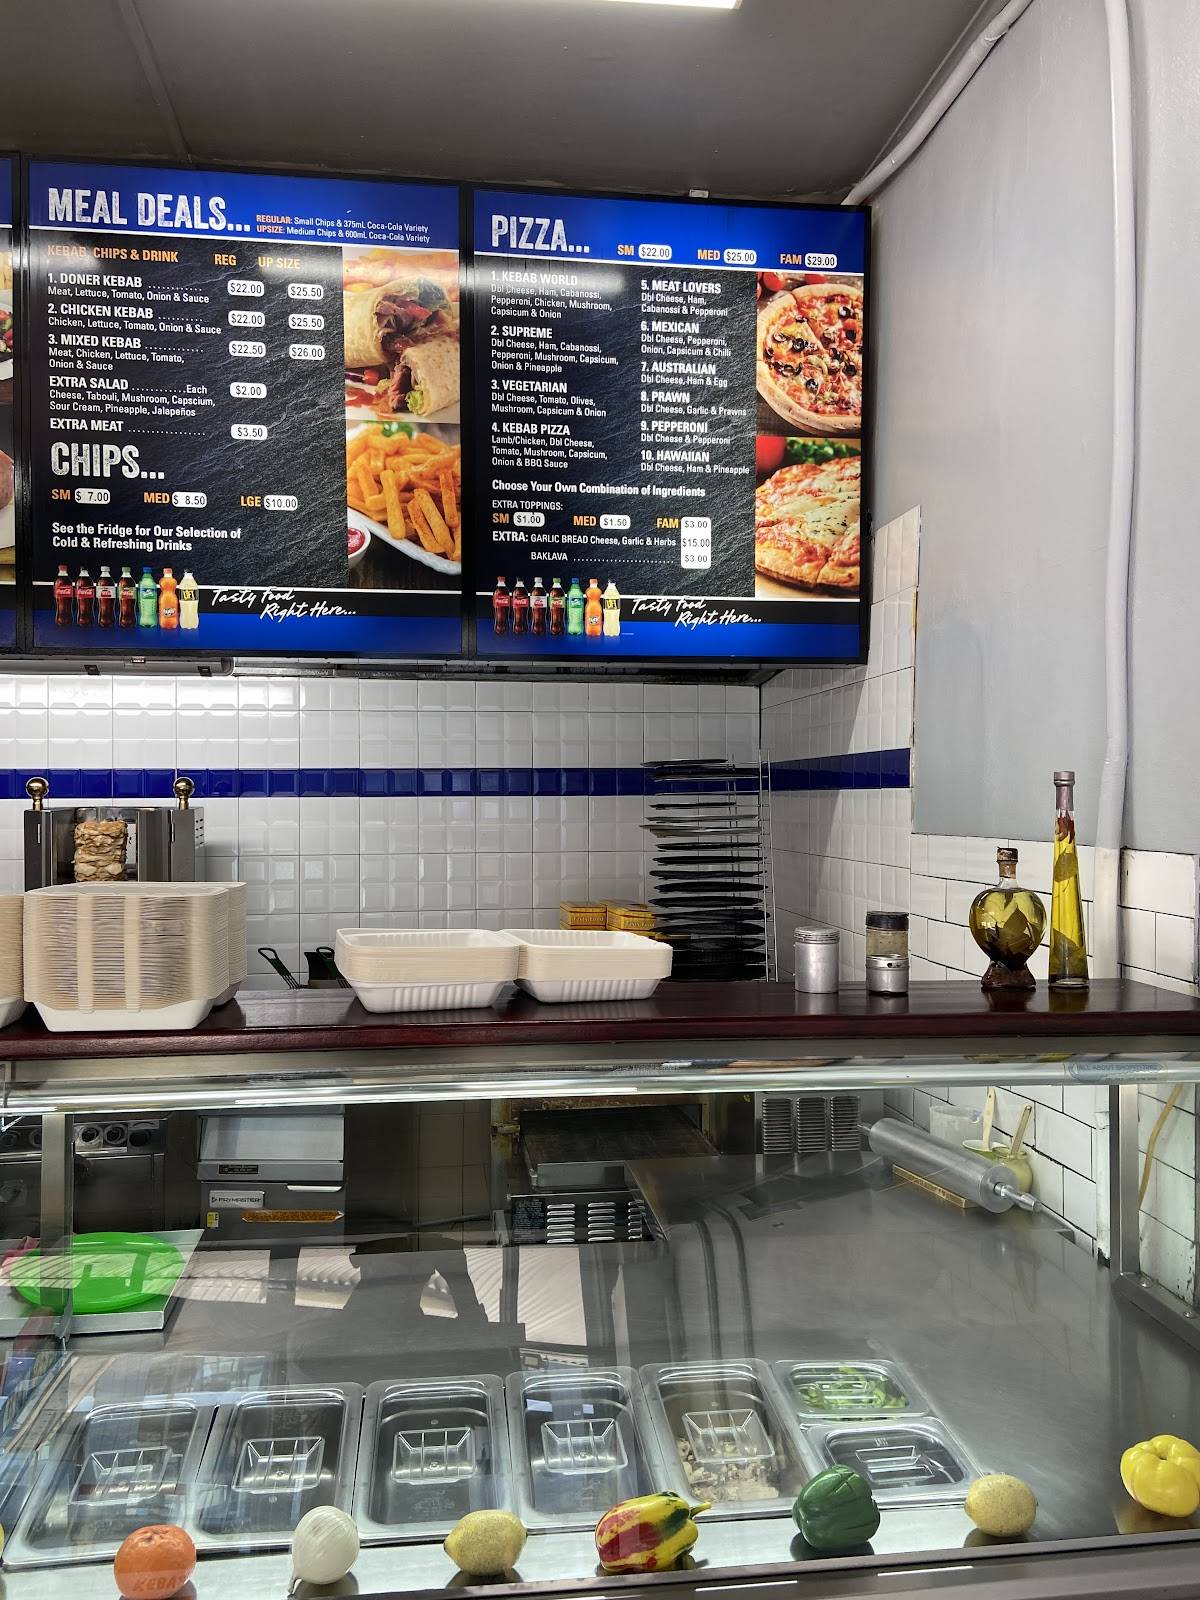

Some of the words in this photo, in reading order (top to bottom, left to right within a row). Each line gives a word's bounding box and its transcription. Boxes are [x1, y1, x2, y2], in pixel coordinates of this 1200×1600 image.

[48, 188, 127, 224] MEAL
[137, 193, 250, 231] DEALS...
[257, 215, 292, 224] REGULAR:
[294, 217, 313, 225] Small
[316, 218, 334, 227] Chips
[344, 220, 365, 228] 375mL
[367, 222, 402, 231] Coca-Cola
[404, 223, 428, 233] Variety
[257, 225, 285, 234] UPSIZE:
[287, 227, 315, 236] Medium
[317, 228, 336, 237] Chips
[346, 230, 367, 239] 600mL
[369, 232, 404, 241] Coca-Cola
[406, 234, 430, 243] Variety
[492, 215, 589, 253] PIZZA...
[94, 247, 127, 260] CHIPS
[130, 250, 140, 260] &
[143, 250, 178, 262] DRINK
[214, 254, 236, 265] REG
[618, 245, 634, 256] SM
[641, 247, 669, 258] $22.00
[698, 249, 720, 261] MED
[726, 251, 755, 262] $25.00
[780, 254, 802, 264] FAM
[807, 256, 835, 266] $29.00
[259, 257, 273, 267] UP
[277, 258, 300, 269] SIZE
[48, 273, 57, 283] 1.
[61, 273, 100, 285] DONER
[103, 275, 142, 288] KEBAB
[502, 272, 537, 283] KEBAB
[540, 274, 578, 285] WORLD
[230, 283, 262, 294] $22.00
[291, 286, 322, 297] $25.50
[641, 280, 649, 290] 5.
[652, 280, 680, 291] MEAT
[683, 282, 721, 293] LOVERS
[48, 286, 73, 296] Meat,
[75, 288, 109, 299] Lettuce,
[111, 290, 145, 300] Tomato,
[147, 291, 171, 302] Onion
[173, 293, 180, 302] &
[183, 293, 209, 303] Sauce
[48, 304, 57, 314] 2.
[61, 304, 111, 317] CHICKEN
[114, 306, 153, 319] KEBAB
[642, 304, 680, 314] Cabanossi
[682, 306, 688, 314] &
[690, 307, 728, 317] Pepperoni
[231, 313, 262, 324] $22.00
[291, 317, 322, 327] $25.50
[491, 326, 499, 335] 2.
[502, 326, 552, 338] SUPREME
[641, 321, 649, 331] 6.
[652, 321, 699, 334] MEXICAN
[48, 334, 58, 345] 3.
[61, 335, 98, 347] MIXED
[102, 336, 141, 348] KEBAB
[492, 339, 504, 347] Dbl
[506, 340, 537, 350] Cheese,
[539, 341, 558, 351] Ham,
[561, 343, 601, 353] Cabanossi,
[232, 344, 263, 354] $22.50
[292, 348, 323, 357] $26.00
[641, 362, 649, 371] 7.
[652, 362, 716, 374] AUSTRALIAN
[50, 376, 87, 388] EXTRA
[90, 378, 128, 390] SALAD
[491, 380, 499, 390] 3.
[502, 380, 567, 393] VEGETARIAN
[236, 385, 261, 396] $2.00
[641, 391, 649, 401] 8.
[652, 392, 690, 403] PRAWN
[50, 390, 84, 400] Cheese,
[86, 391, 119, 402] Tabouli,
[122, 393, 170, 404] Mushroom,
[172, 396, 215, 407] Capscium,
[50, 401, 70, 411] Sour
[73, 402, 103, 414] Cream,
[105, 404, 150, 415] Pineapple,
[152, 406, 196, 417] Jalapeños
[50, 419, 87, 430] EXTRA
[91, 420, 124, 432] MEAT
[492, 422, 500, 432] 4.
[503, 423, 537, 434] KEBAB
[541, 424, 570, 435] PIZZA
[641, 421, 649, 431] 9.
[652, 421, 707, 433] PEPPERONI
[237, 427, 263, 438] $3.50
[492, 435, 547, 446] Lamb/Chicken,
[550, 437, 562, 445] Dbl
[564, 438, 594, 448] Cheese,
[52, 442, 164, 479] CHIPS...
[641, 450, 654, 460] 10.
[657, 451, 709, 462] HAWAIIAN
[493, 480, 528, 491] Choose
[530, 481, 553, 492] Your
[555, 483, 577, 493] Own
[579, 483, 638, 495] Combination
[641, 485, 650, 495] of
[653, 485, 705, 497] Ingredients
[52, 489, 70, 500] SM
[144, 492, 169, 504] MED
[240, 496, 261, 507] LGE
[266, 498, 297, 508] $10.00
[493, 500, 518, 509] EXTRA
[520, 501, 563, 511] TOPPINGS:
[493, 513, 509, 523] SM
[517, 515, 541, 524] $1.00
[573, 516, 596, 526] MED
[604, 518, 627, 526] $1.50
[657, 518, 678, 528] FAM
[684, 520, 708, 528] $3.00
[52, 523, 74, 534] See
[77, 523, 94, 535] the
[98, 524, 132, 537] Fridge
[135, 525, 150, 536] for
[154, 526, 173, 537] Our
[176, 526, 227, 538] Selection
[230, 528, 241, 538] of
[53, 536, 77, 548] Cold
[81, 537, 90, 548] &
[93, 538, 153, 552] Refreshing
[156, 539, 192, 550] Drinks
[493, 532, 528, 542] EXTRA:
[531, 534, 559, 543] GARLIC
[562, 535, 588, 544] BREAD
[590, 536, 620, 546] Cheese,
[622, 537, 644, 545] Garlic
[646, 537, 652, 545] &
[654, 538, 676, 546] Herbs
[682, 539, 710, 547] $15.00
[531, 552, 568, 561] BAKLAVA
[212, 588, 256, 608] Tasty
[260, 586, 295, 602] Food
[631, 598, 671, 614] Tasty
[675, 595, 706, 610] Food
[260, 602, 305, 622] Right
[675, 611, 717, 630] Right
